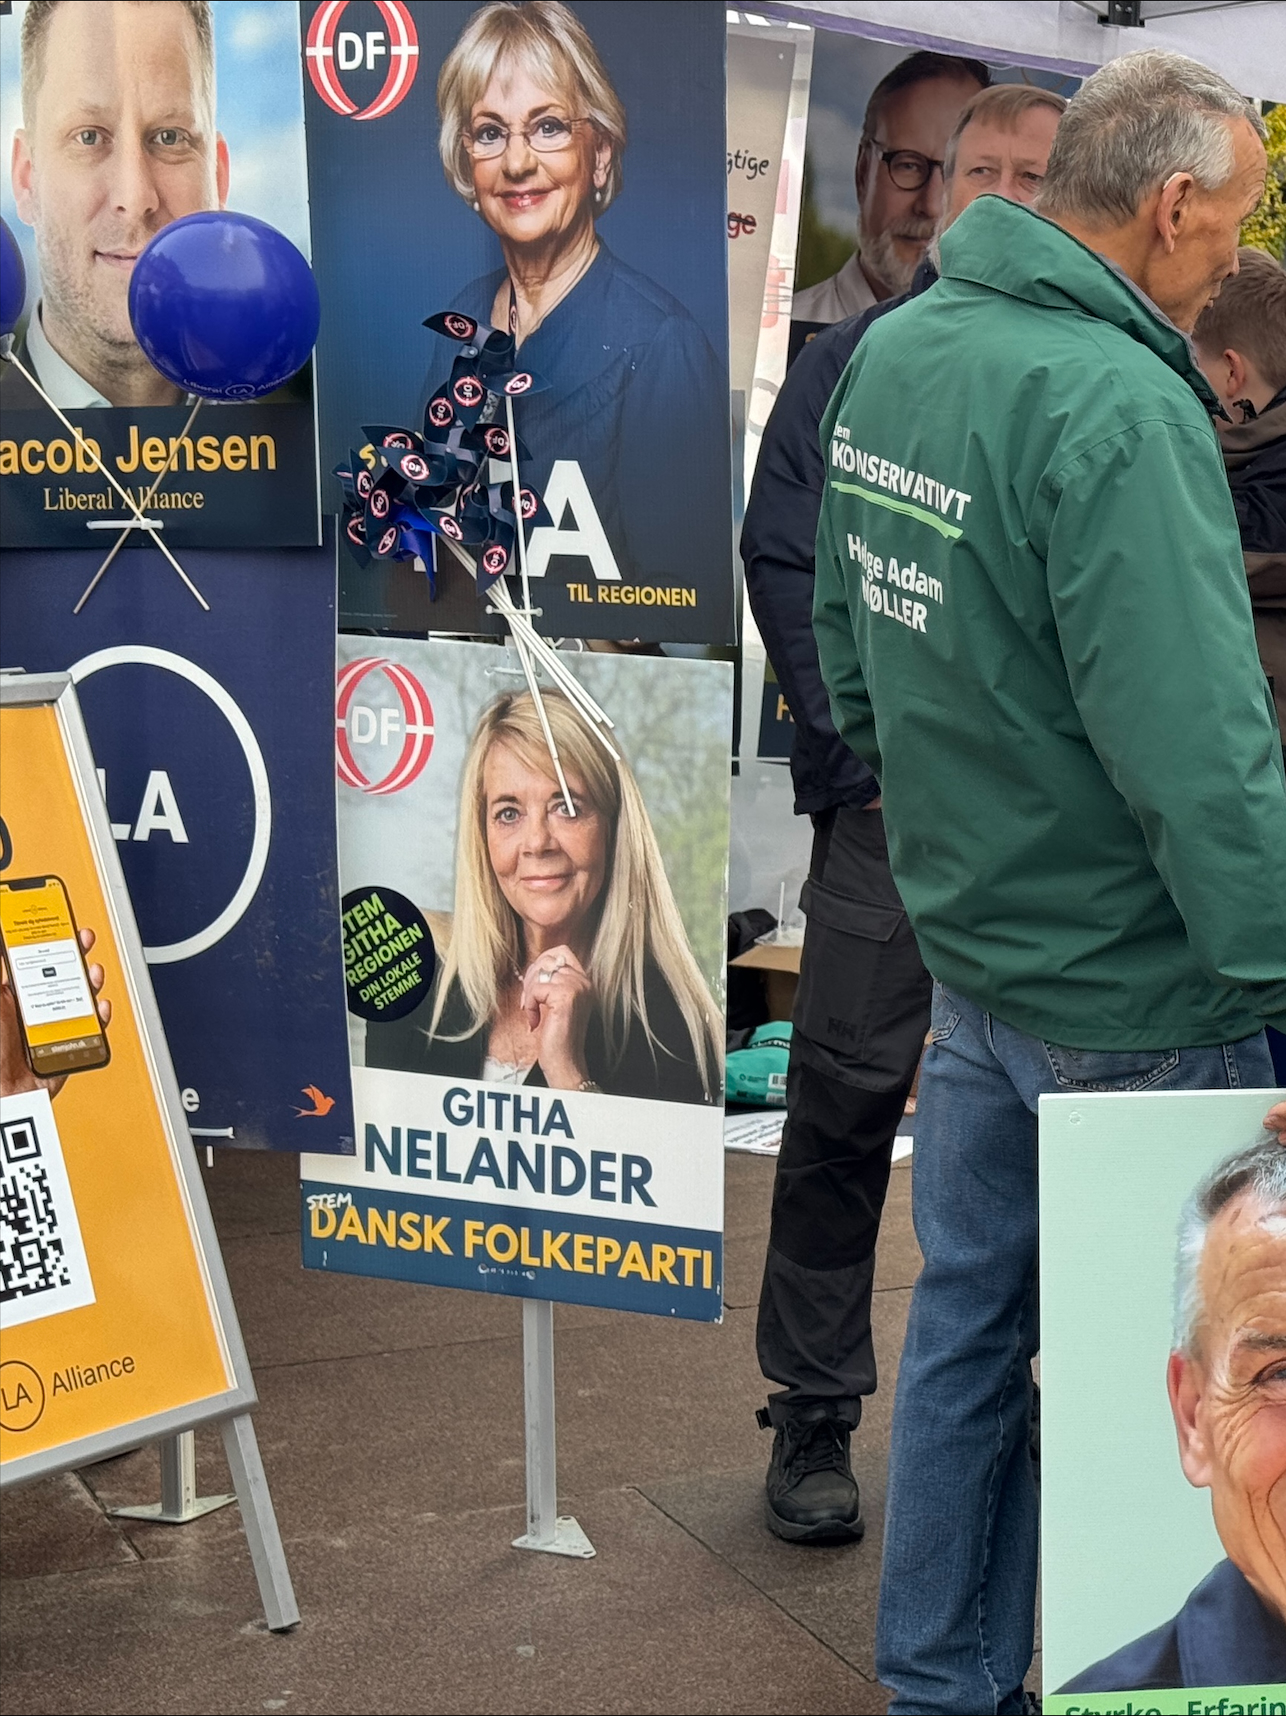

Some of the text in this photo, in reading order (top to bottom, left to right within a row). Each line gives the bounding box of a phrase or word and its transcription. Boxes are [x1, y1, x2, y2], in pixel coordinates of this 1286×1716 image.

[338, 31, 386, 70] DF
[436, 405, 448, 420] DF
[462, 384, 473, 399] DF
[116, 425, 277, 474] Jensen
[408, 462, 422, 473] DF
[43, 486, 205, 511] Liberal Alliance
[831, 440, 972, 521] KONSERVATIVT
[847, 533, 944, 606] Hlge Adam
[566, 583, 696, 607] TIL REGIONEN
[351, 705, 400, 746] DF
[343, 912, 403, 966] GITHA
[346, 922, 424, 988] REGIONEN
[359, 951, 422, 1003] DIN LOKALE
[374, 970, 422, 1011] STEMME
[442, 1087, 574, 1139] GITHA
[364, 1122, 658, 1208] NELANDER
[306, 1191, 352, 1211] STEM
[310, 1204, 713, 1290] DANSK FOLKEPARTI
[1, 1356, 135, 1411] LA Alliance
